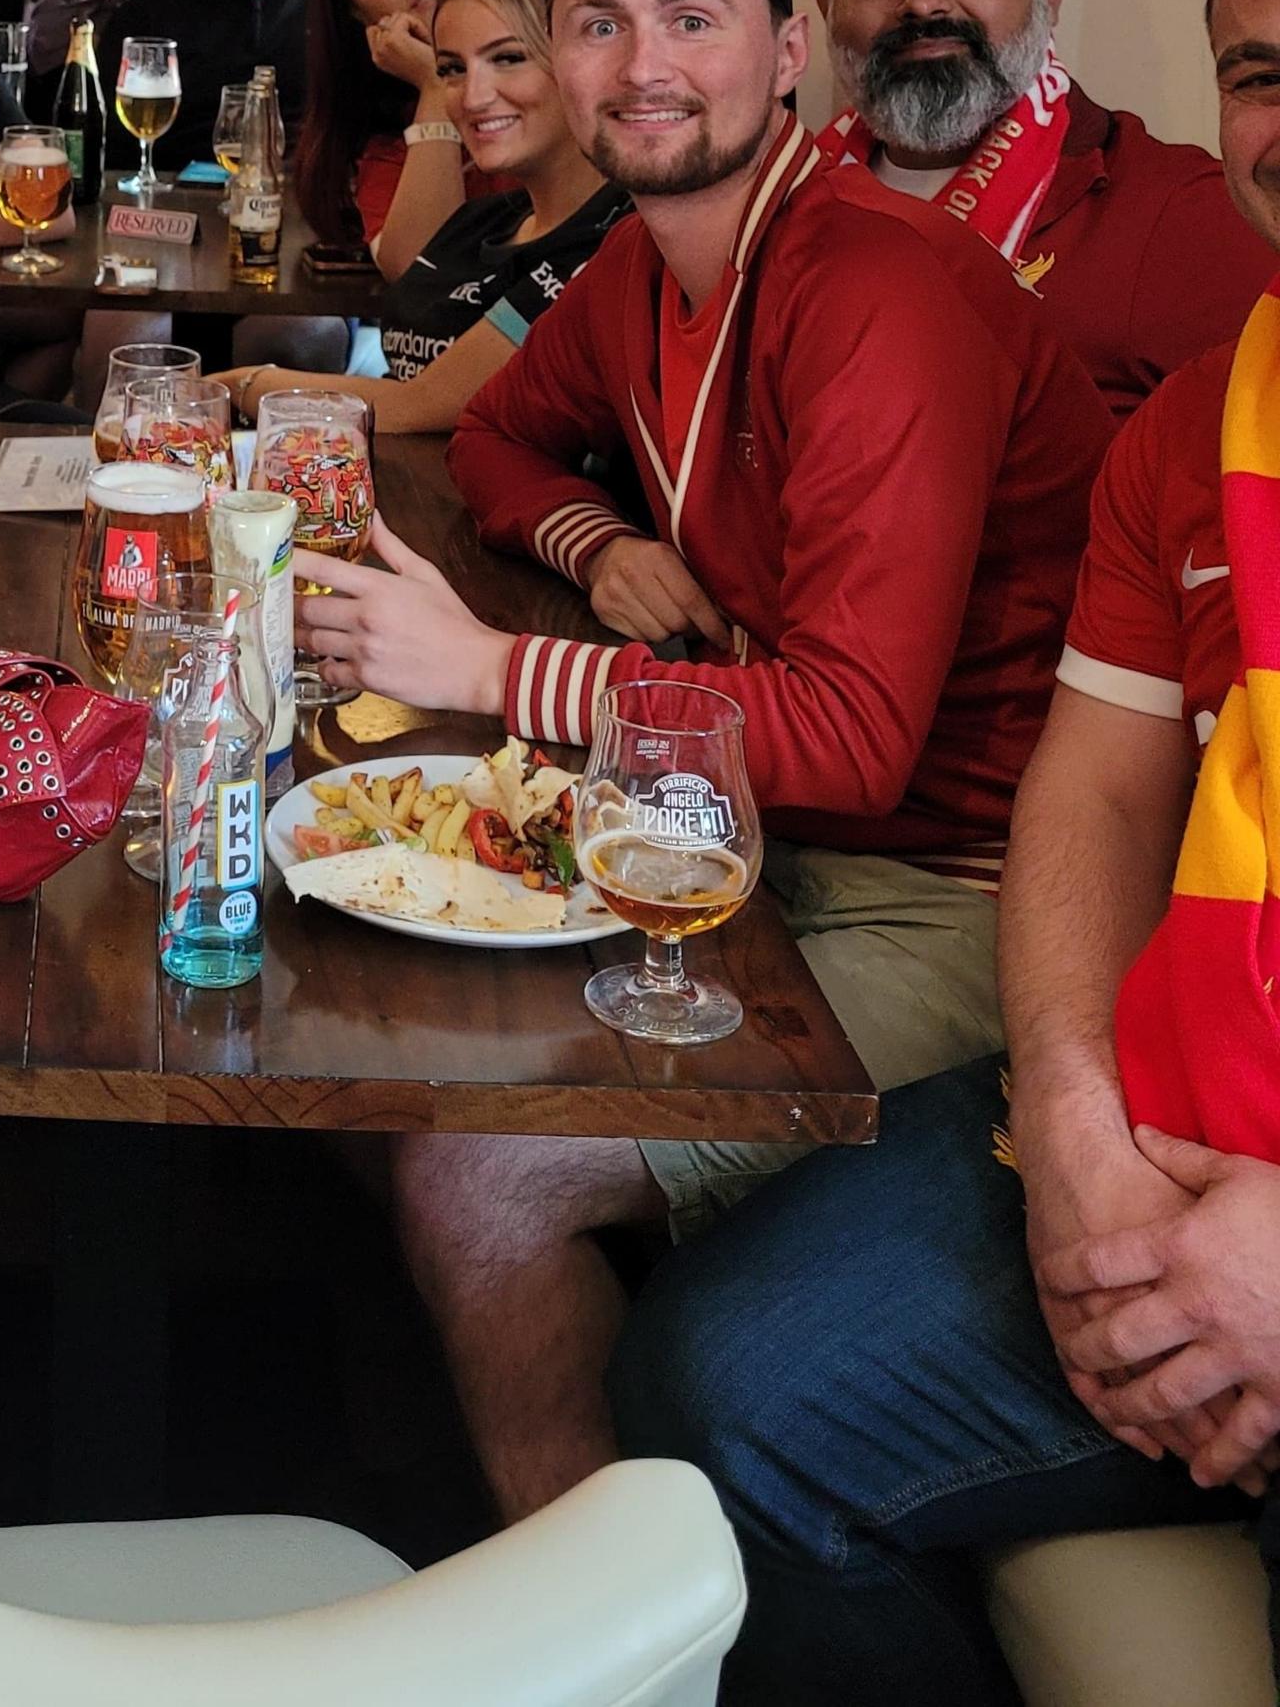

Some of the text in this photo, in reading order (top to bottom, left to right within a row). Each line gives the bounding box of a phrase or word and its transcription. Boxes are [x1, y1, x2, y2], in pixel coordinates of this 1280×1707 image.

[116, 210, 190, 236] RESERVED
[659, 777, 709, 794] BIRRIFICIO
[663, 792, 704, 808] ANGELO
[643, 804, 726, 837] PORETTI
[228, 790, 252, 880] WKD
[225, 901, 252, 919] BLUE
